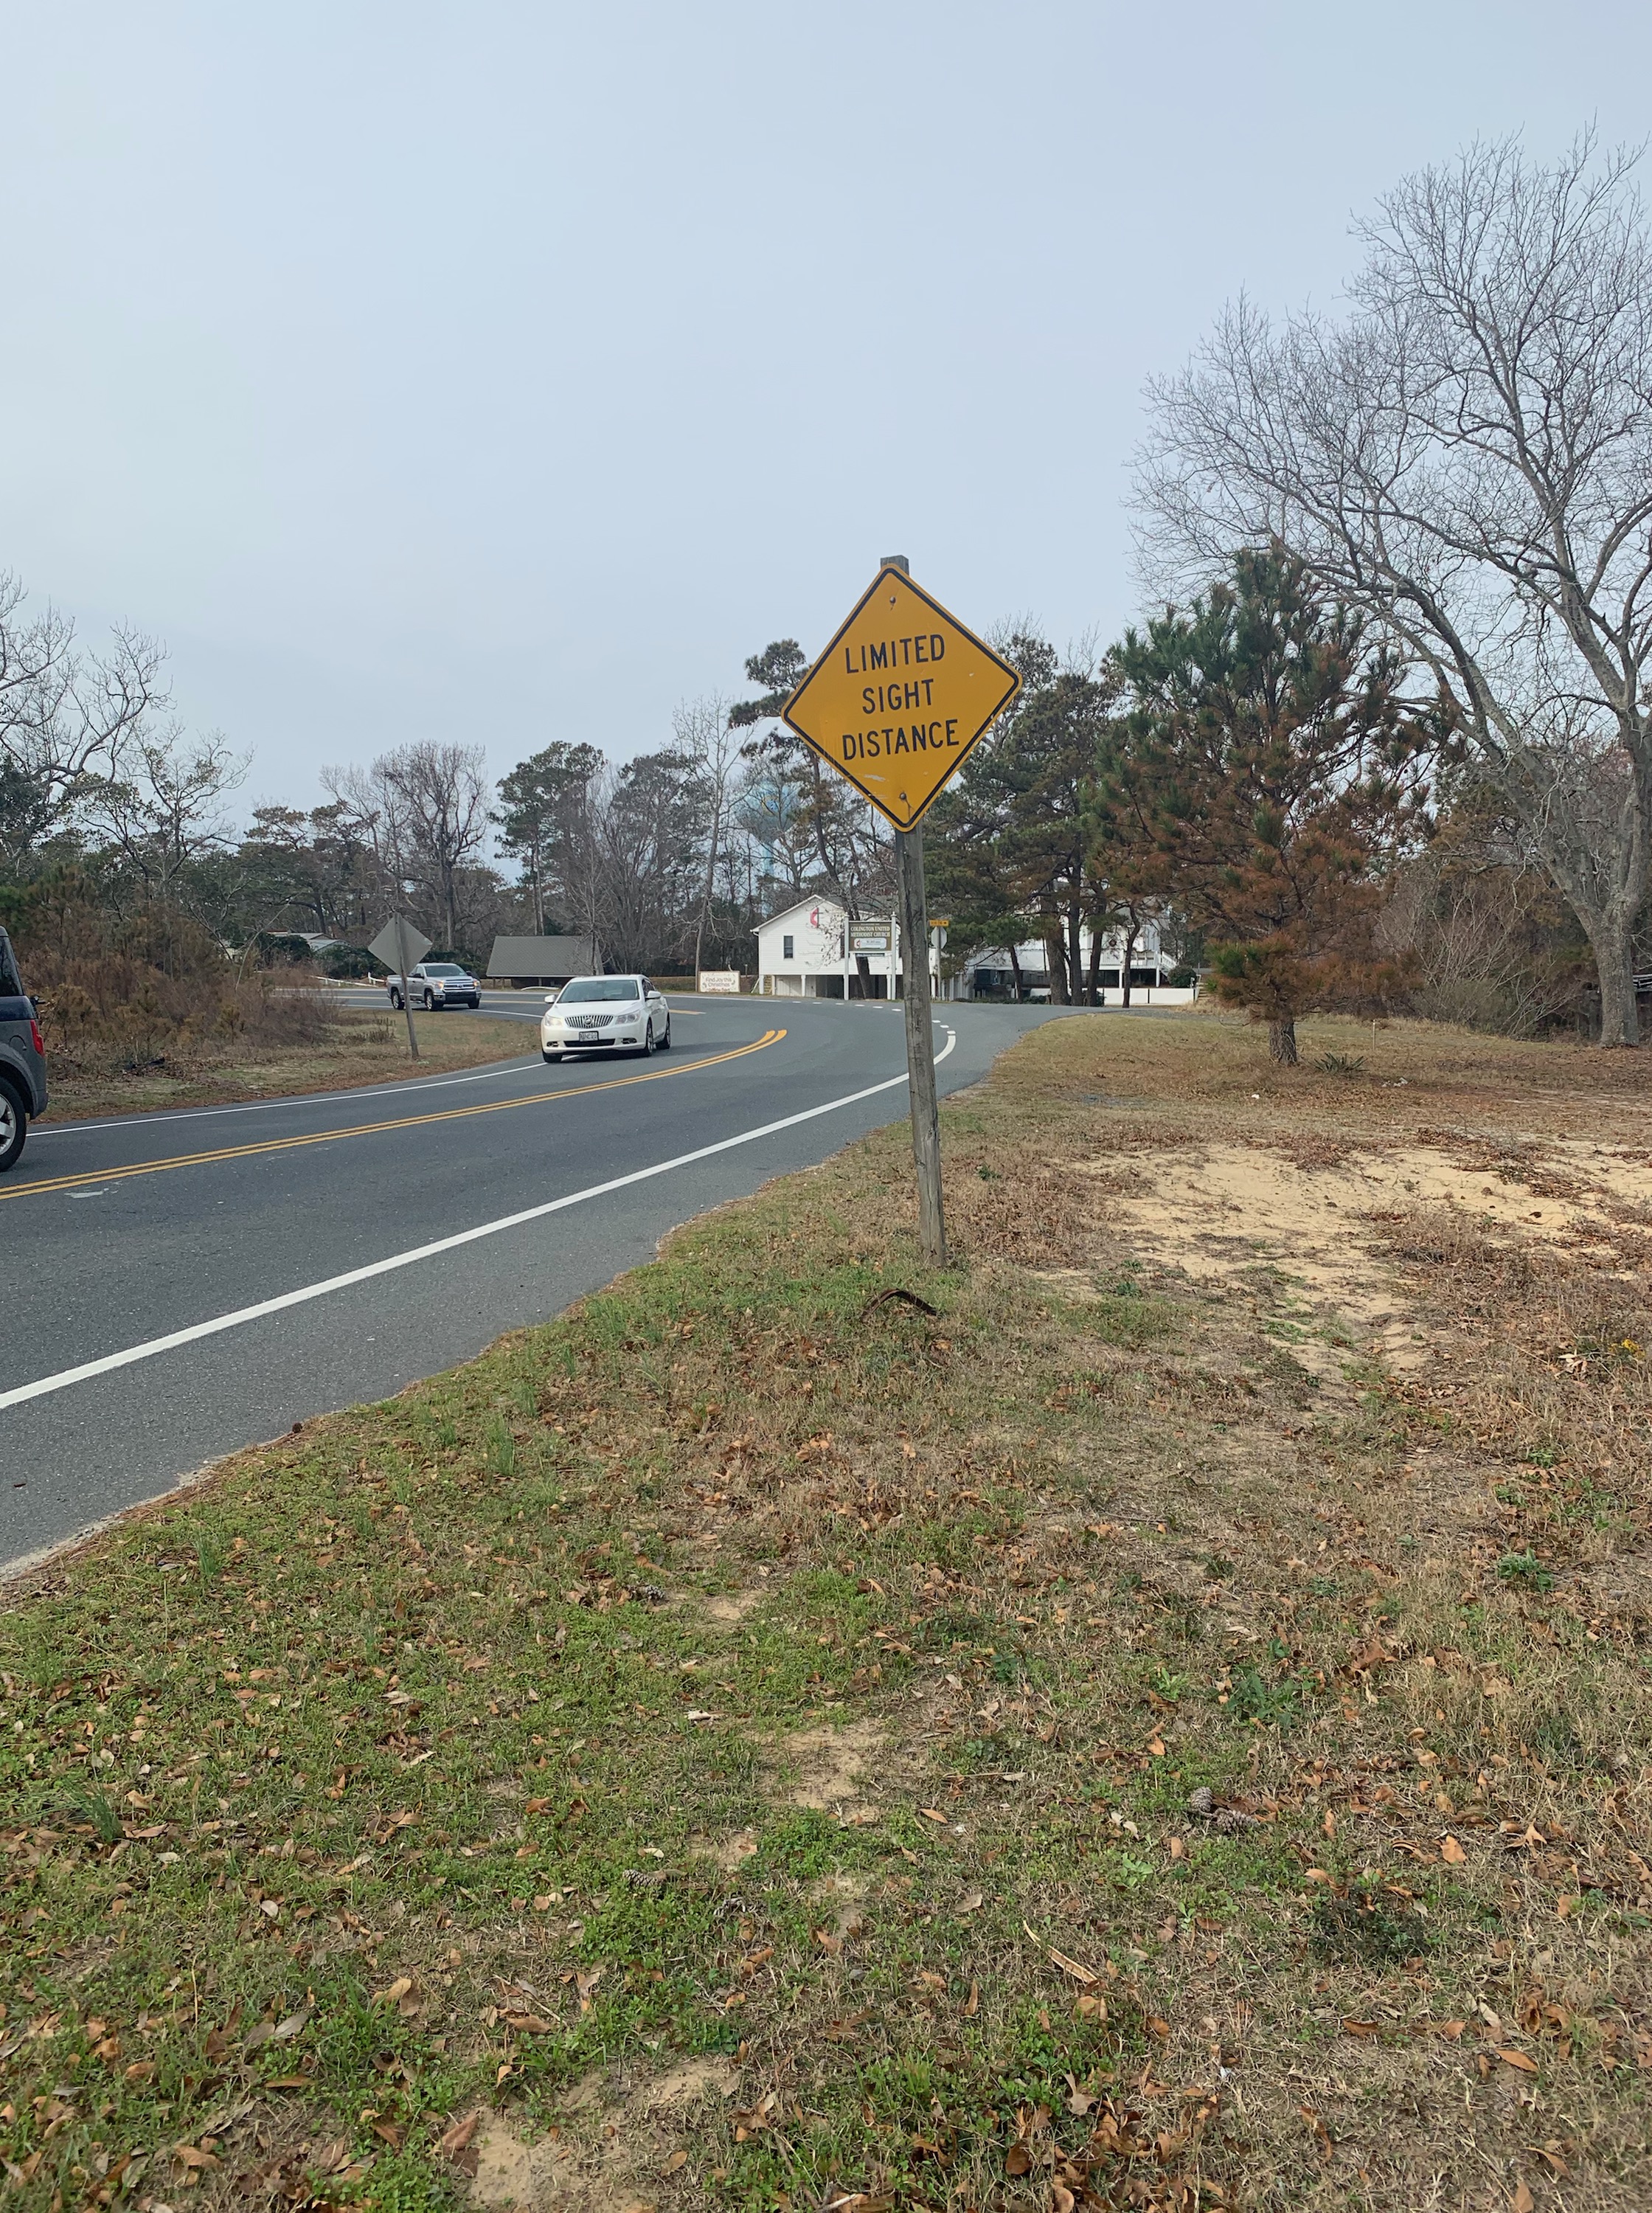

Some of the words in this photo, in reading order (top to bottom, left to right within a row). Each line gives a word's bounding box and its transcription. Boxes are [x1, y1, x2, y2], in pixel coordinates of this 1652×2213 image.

[845, 634, 945, 674] LIMITED
[861, 678, 934, 715] SIGHT
[842, 718, 959, 761] DISTANCE
